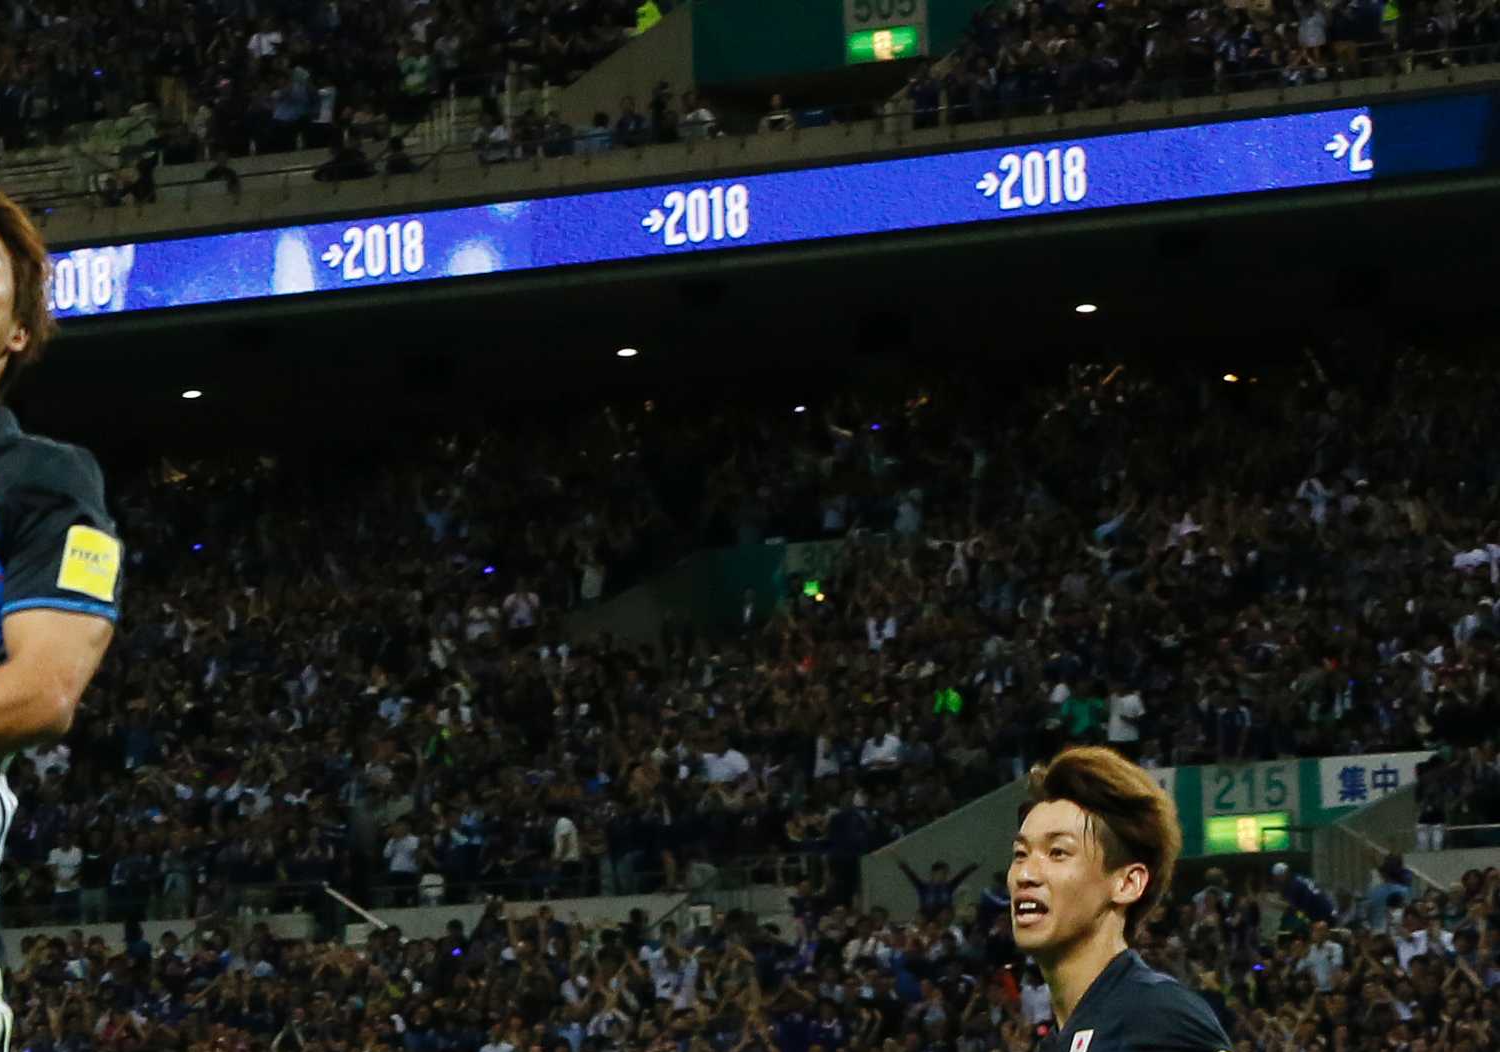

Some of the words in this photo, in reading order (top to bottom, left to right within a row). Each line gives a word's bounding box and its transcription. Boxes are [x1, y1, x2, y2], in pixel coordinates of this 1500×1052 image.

[1000, 147, 1086, 209] 2018
[665, 184, 748, 245] 2018
[344, 220, 424, 279] 2018
[1213, 765, 1289, 811] 215
[1338, 763, 1399, 801] 集中
